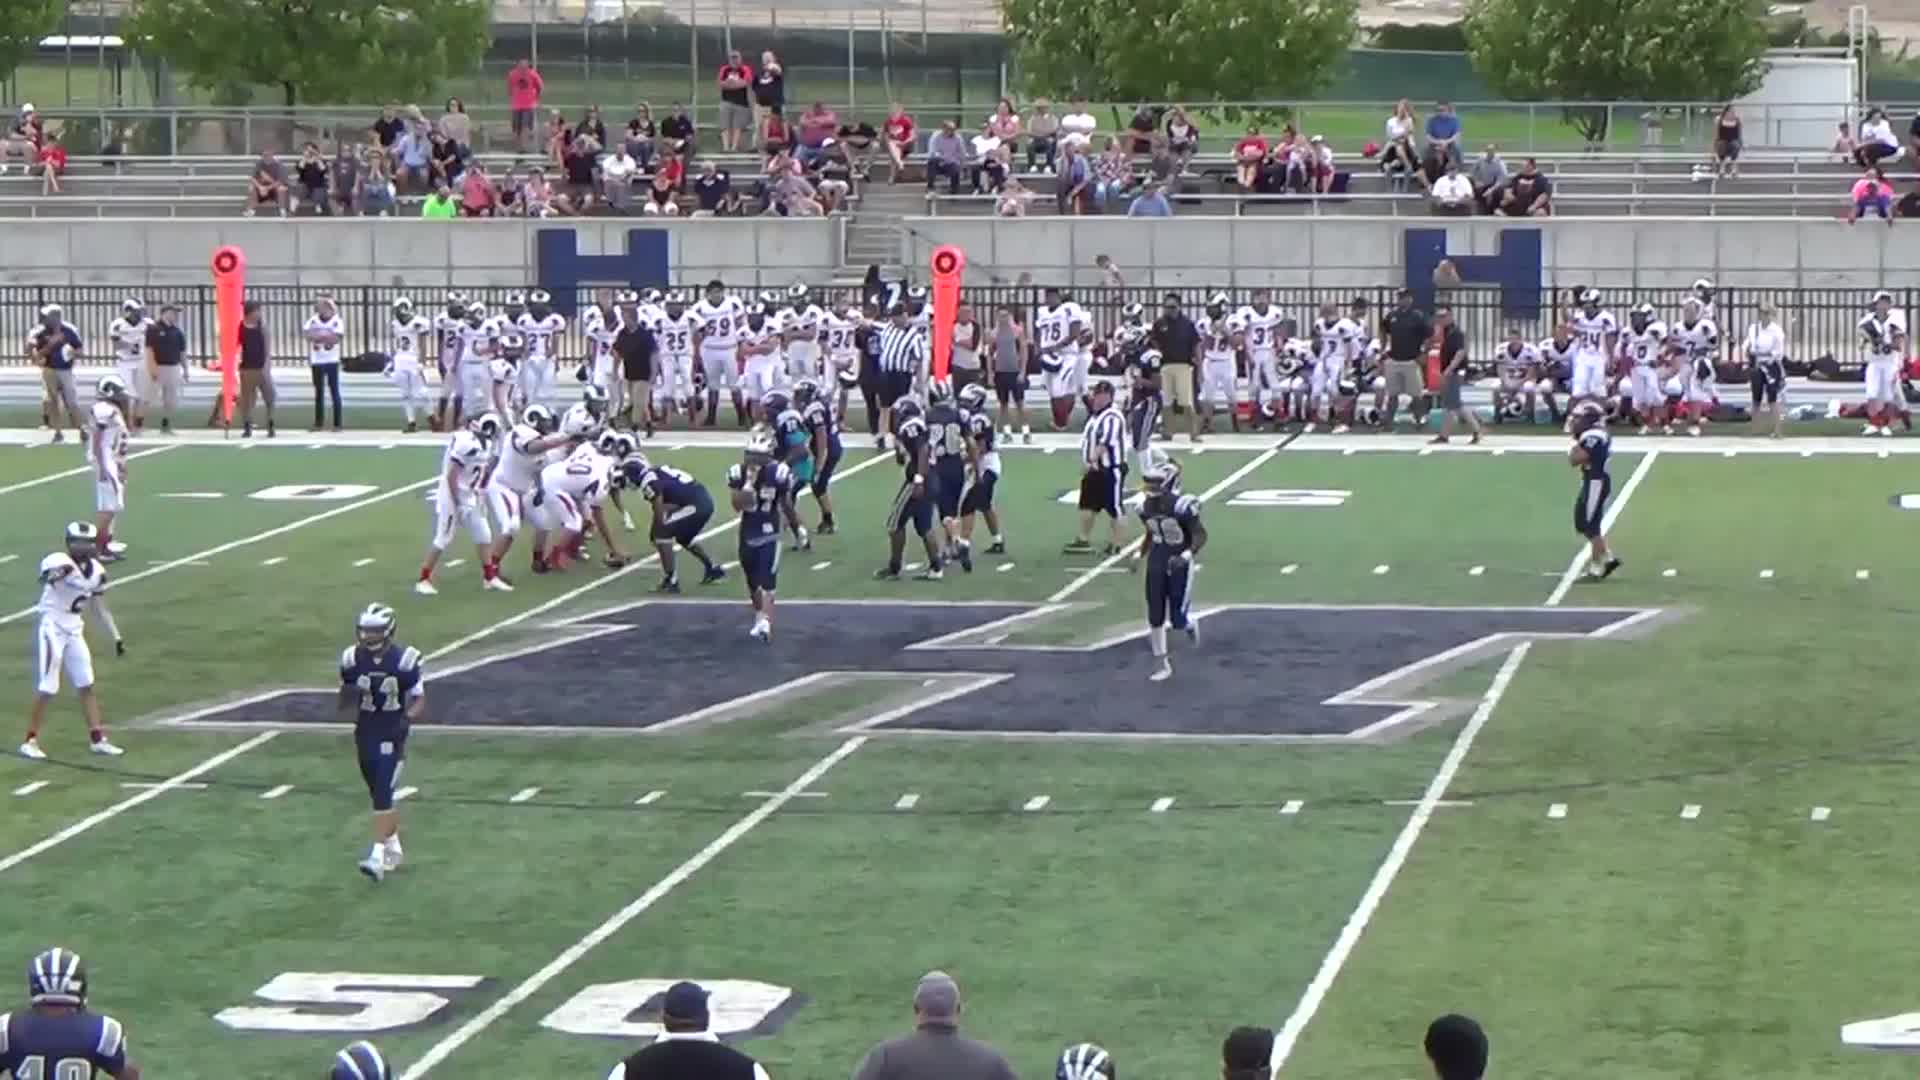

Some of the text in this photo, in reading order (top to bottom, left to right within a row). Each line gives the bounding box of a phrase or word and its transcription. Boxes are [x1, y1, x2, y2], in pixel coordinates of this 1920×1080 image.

[537, 229, 668, 318] H
[1405, 228, 1541, 320] H
[357, 674, 401, 713] 11
